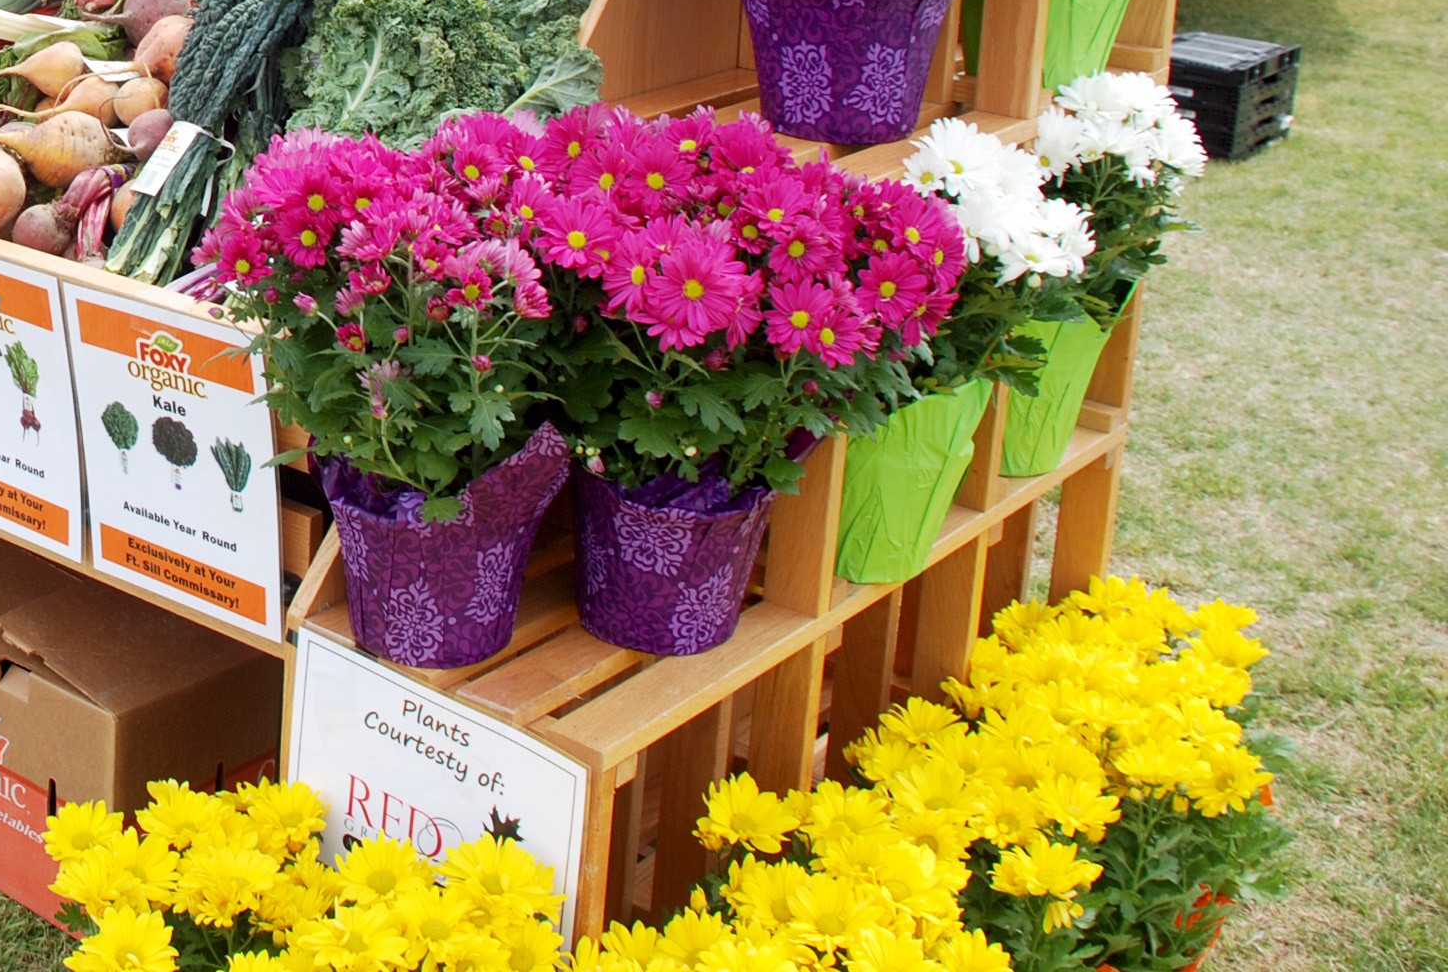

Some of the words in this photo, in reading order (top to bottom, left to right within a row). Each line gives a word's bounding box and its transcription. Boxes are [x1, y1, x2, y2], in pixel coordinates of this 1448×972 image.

[127, 360, 207, 399] organic
[139, 341, 187, 373] FOXY
[152, 394, 186, 416] Kale
[15, 458, 45, 478] Round
[8, 488, 18, 501] at
[20, 494, 44, 512] Your
[123, 500, 170, 527] Available
[172, 518, 197, 536] Year
[202, 530, 237, 552] Round
[126, 553, 140, 568] Ft.
[143, 559, 160, 576] Sill
[164, 569, 239, 609] Commissary!
[128, 537, 191, 573] Exclusively
[194, 564, 206, 577] at
[209, 569, 236, 589] Your
[402, 699, 471, 747] Plants
[364, 711, 469, 783] Courtesty
[478, 771, 505, 796] of:
[345, 773, 442, 858] RED
